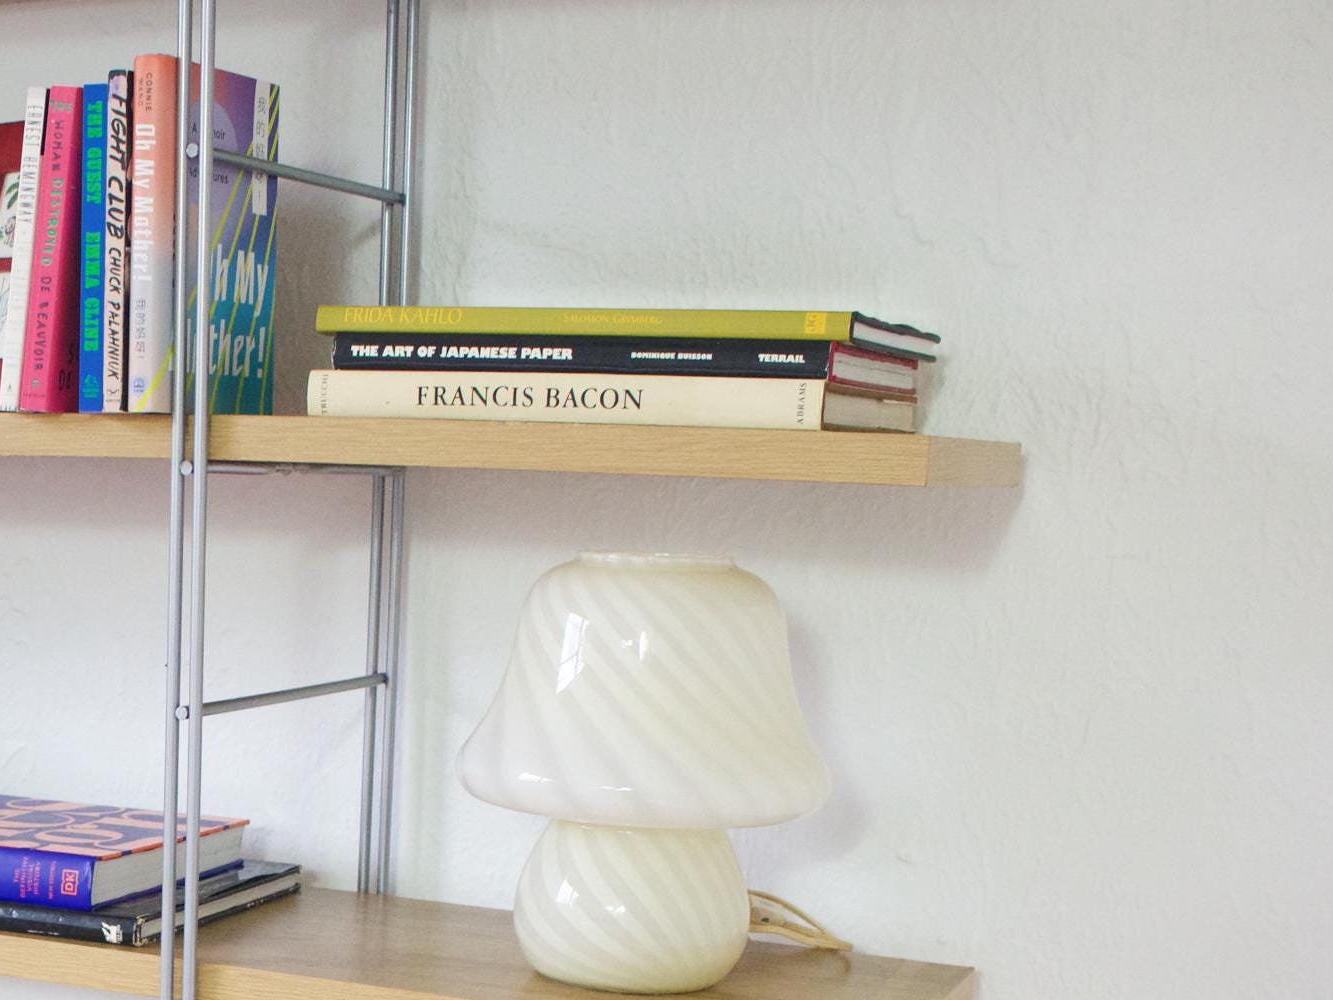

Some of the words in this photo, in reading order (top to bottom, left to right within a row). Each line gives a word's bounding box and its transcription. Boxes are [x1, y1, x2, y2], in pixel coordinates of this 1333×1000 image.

[145, 72, 153, 112] CONNIE
[25, 105, 44, 146] ERNEST
[87, 101, 103, 139] THE
[109, 93, 127, 171] FIGHT
[135, 123, 156, 151] Oh
[51, 120, 65, 171] WOMAN
[18, 156, 38, 223] HEMINGWAY
[86, 147, 103, 204] GUEST
[133, 159, 155, 188] My
[38, 178, 64, 267] DESTROYED
[106, 175, 125, 240] CLUB
[84, 231, 101, 289] EMMA
[132, 195, 155, 281] Mother!
[39, 275, 52, 293] DE
[108, 247, 123, 295] CHUCK
[234, 250, 268, 318] My
[33, 301, 50, 370] BEAUVOIR
[83, 297, 100, 352] CLINE
[107, 300, 120, 380] PALAHNIUK
[343, 306, 395, 325] FRIDA
[398, 307, 463, 326] KAHLO
[351, 345, 378, 357] THE
[382, 346, 414, 358] ART
[417, 346, 436, 358] OF
[439, 347, 517, 359] JAPANESE
[520, 347, 573, 361] PAPER
[630, 352, 675, 361] DOMINIQUE
[758, 353, 805, 364] TERRAIL
[417, 385, 534, 407] FRANCIS
[544, 387, 643, 410] BACON
